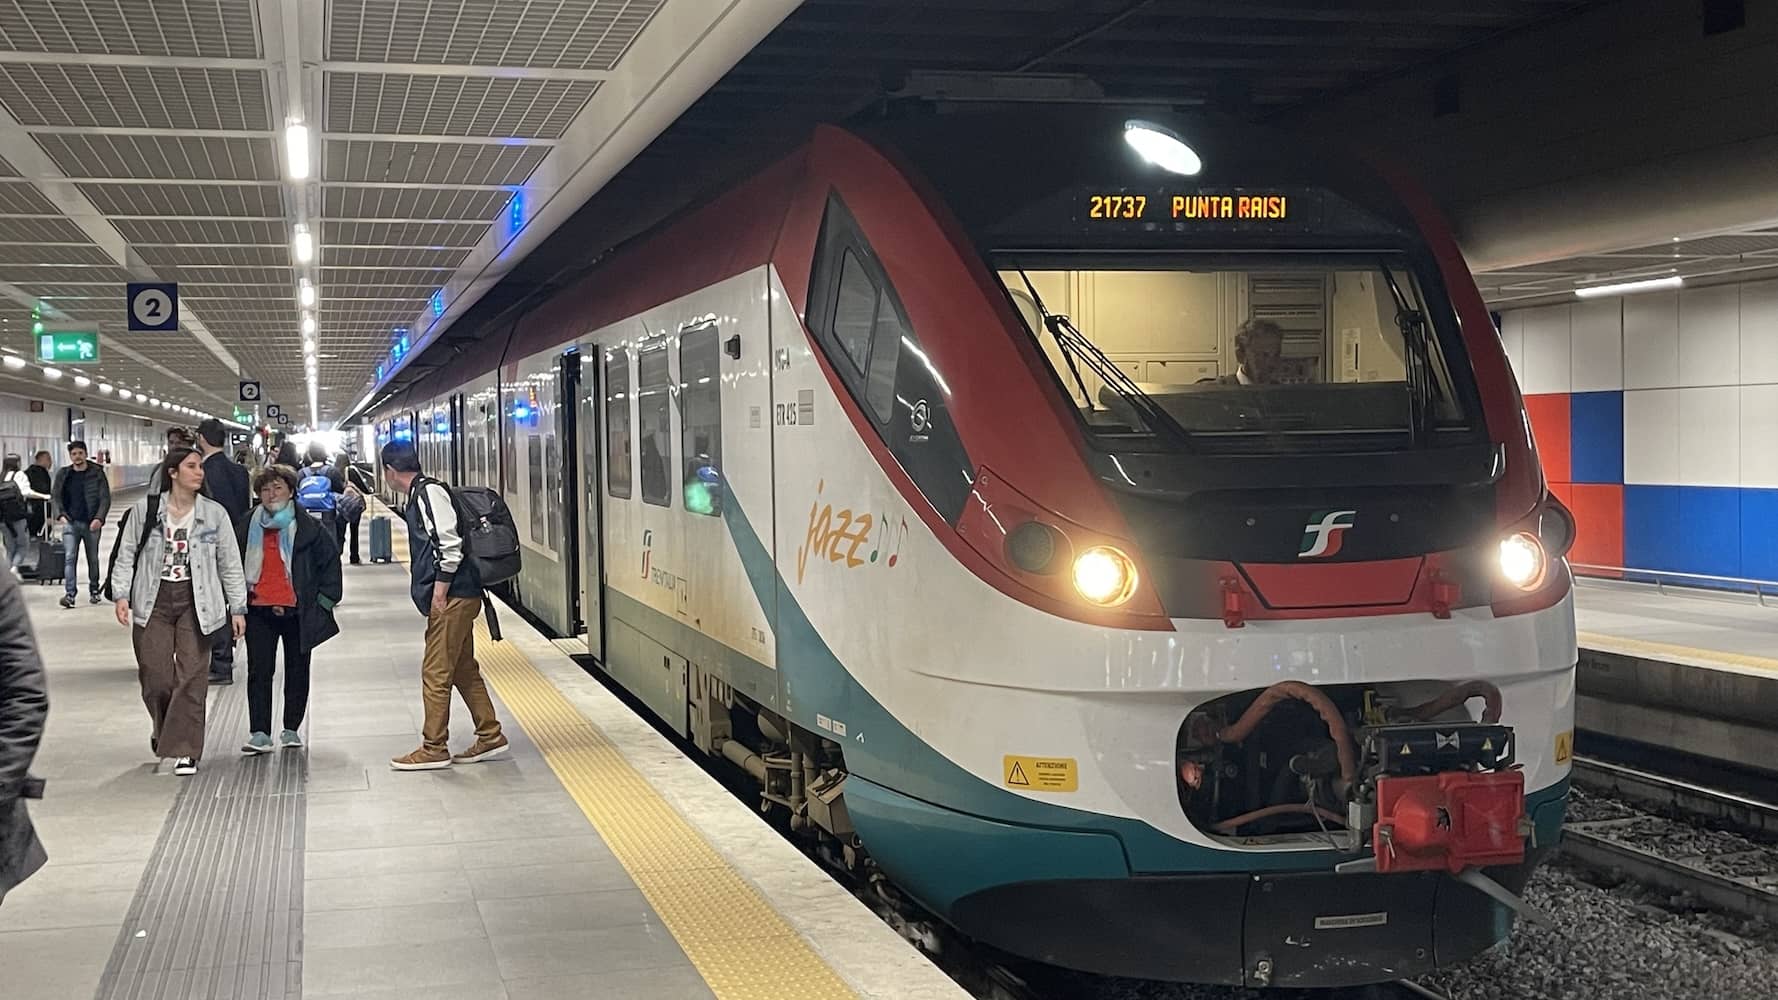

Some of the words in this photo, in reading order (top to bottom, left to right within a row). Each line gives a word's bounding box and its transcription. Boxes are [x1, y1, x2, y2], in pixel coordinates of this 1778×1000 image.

[1090, 196, 1146, 218] 21737
[1172, 196, 1232, 218] PUNTA
[1238, 196, 1286, 218] RAISI
[145, 298, 160, 317] 2
[798, 479, 873, 585] jazz
